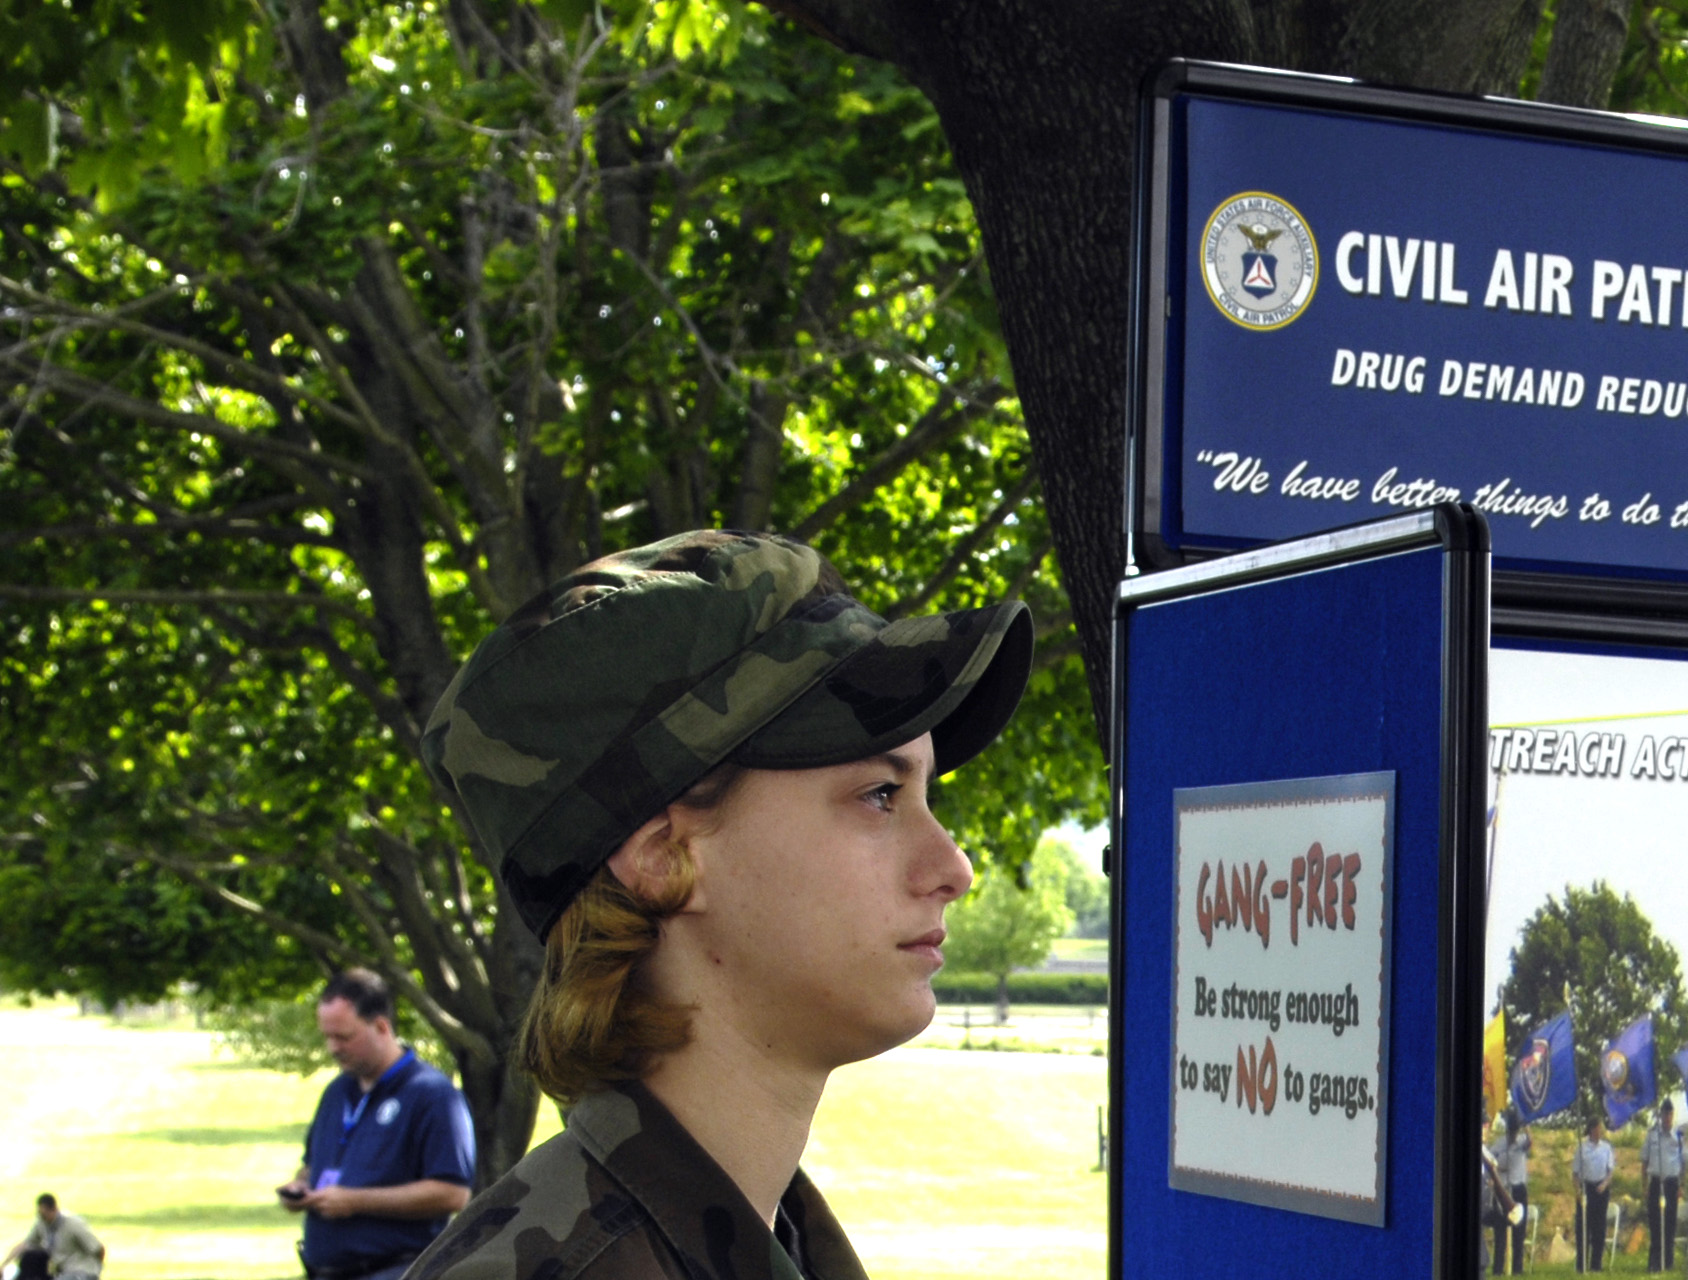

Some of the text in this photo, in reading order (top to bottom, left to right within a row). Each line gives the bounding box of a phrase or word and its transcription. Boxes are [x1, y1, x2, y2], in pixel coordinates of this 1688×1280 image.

[1247, 199, 1263, 209] AIR
[1336, 231, 1468, 304] CIVIL
[1484, 249, 1573, 315] AIR
[1242, 311, 1260, 323] AIR
[1331, 349, 1426, 393] DRUG
[1439, 360, 1585, 407] DEMAND
[1281, 461, 1359, 500] have
[1371, 467, 1460, 505] better
[1472, 477, 1569, 528] things
[1579, 493, 1611, 520] to
[1622, 493, 1661, 524] do
[1196, 842, 1361, 949] GANG-FREE
[1194, 976, 1359, 1036] Be strong enough
[1180, 1036, 1375, 1119] to say NO to gangs.
